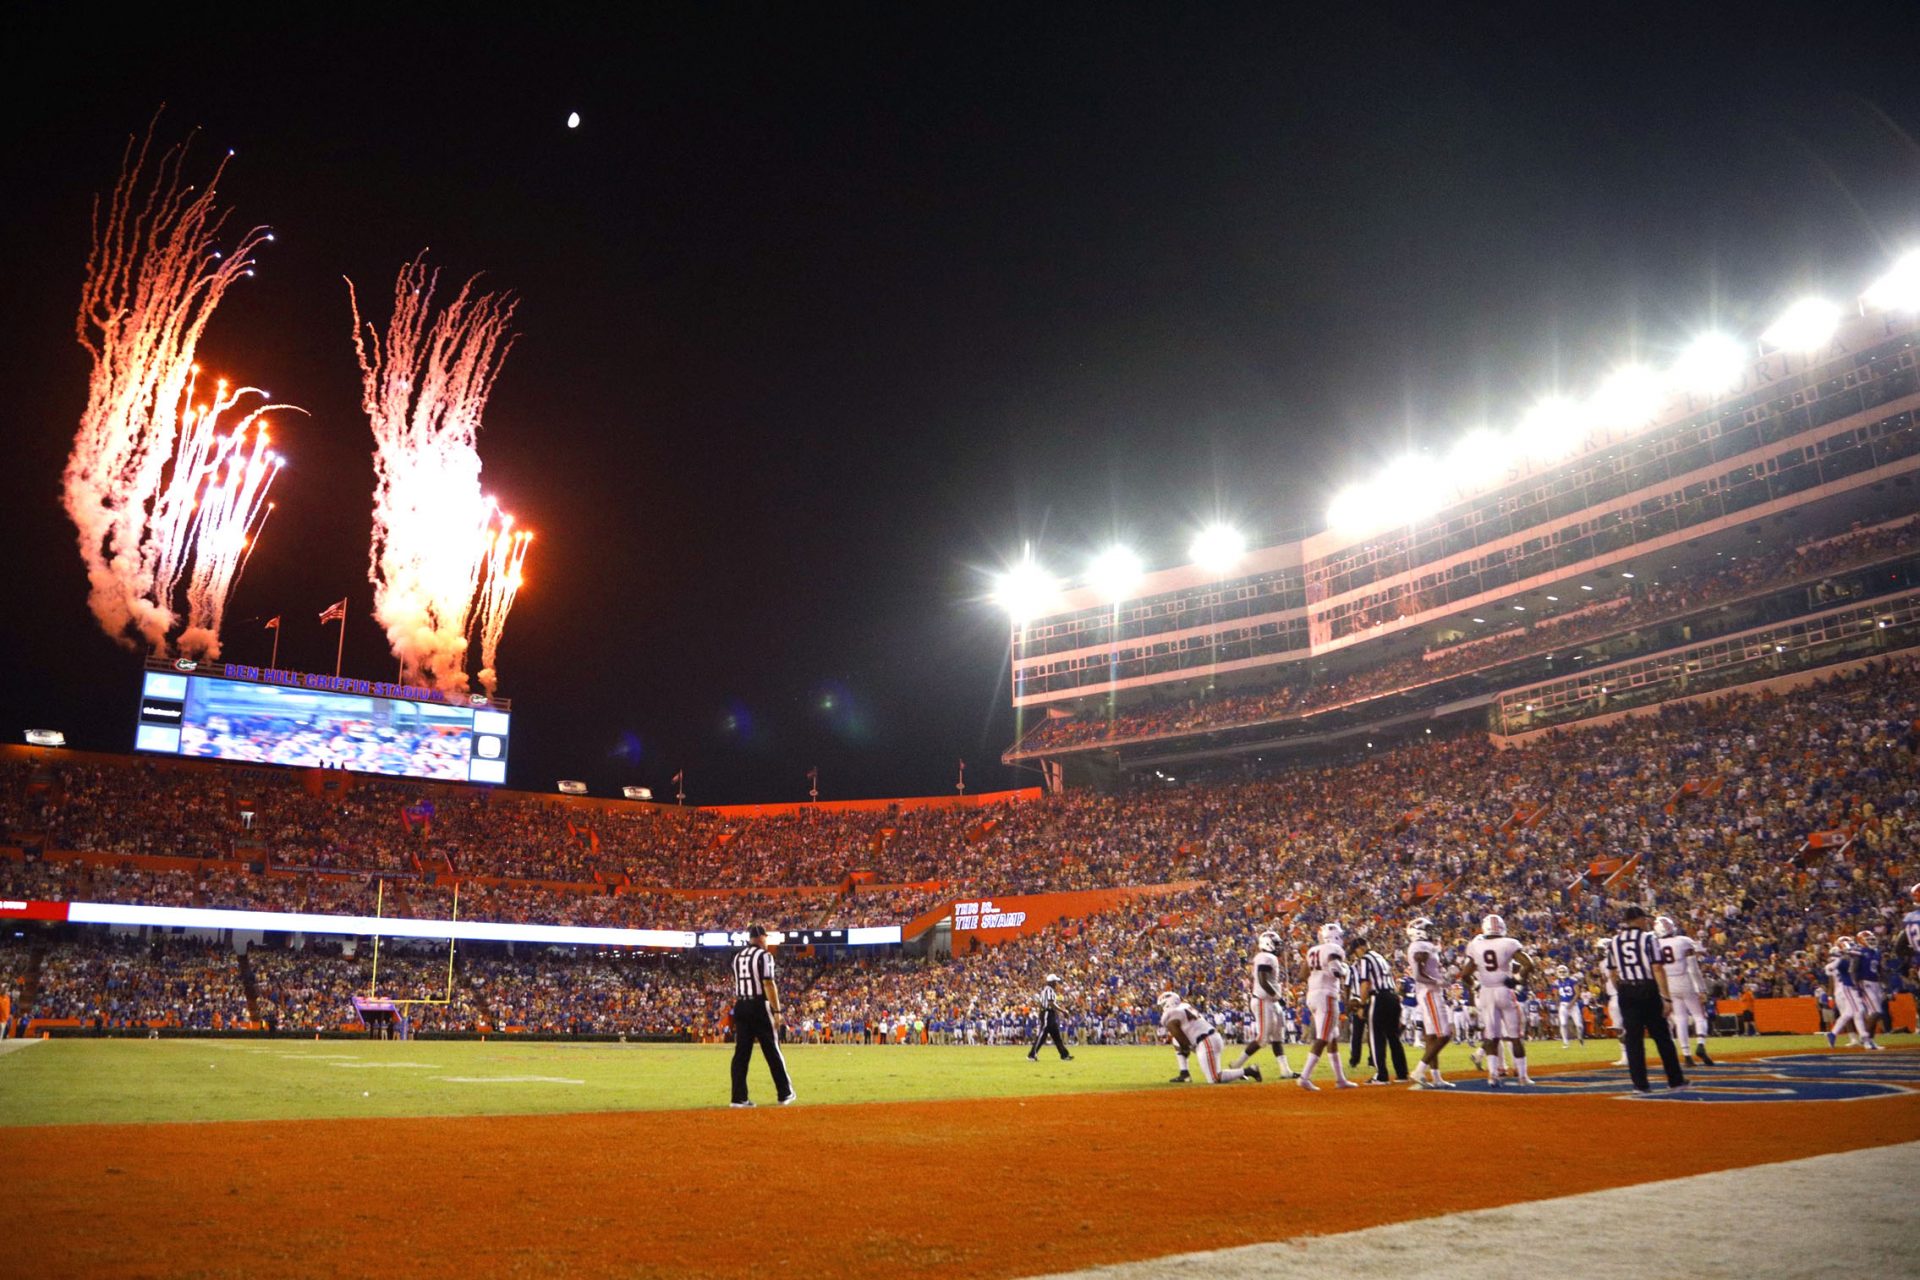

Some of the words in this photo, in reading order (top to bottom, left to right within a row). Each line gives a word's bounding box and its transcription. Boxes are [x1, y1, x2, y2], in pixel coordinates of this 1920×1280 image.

[224, 663, 260, 682] BEN
[263, 667, 300, 686] HILL
[304, 672, 369, 695] GRIFFIN
[374, 681, 445, 702] STADIUM
[954, 902, 979, 915] THIS
[954, 915, 979, 930] THE
[980, 911, 1026, 929] SWAMP
[1483, 949, 1499, 972] 9
[1621, 941, 1638, 964] S
[738, 955, 751, 978] H
